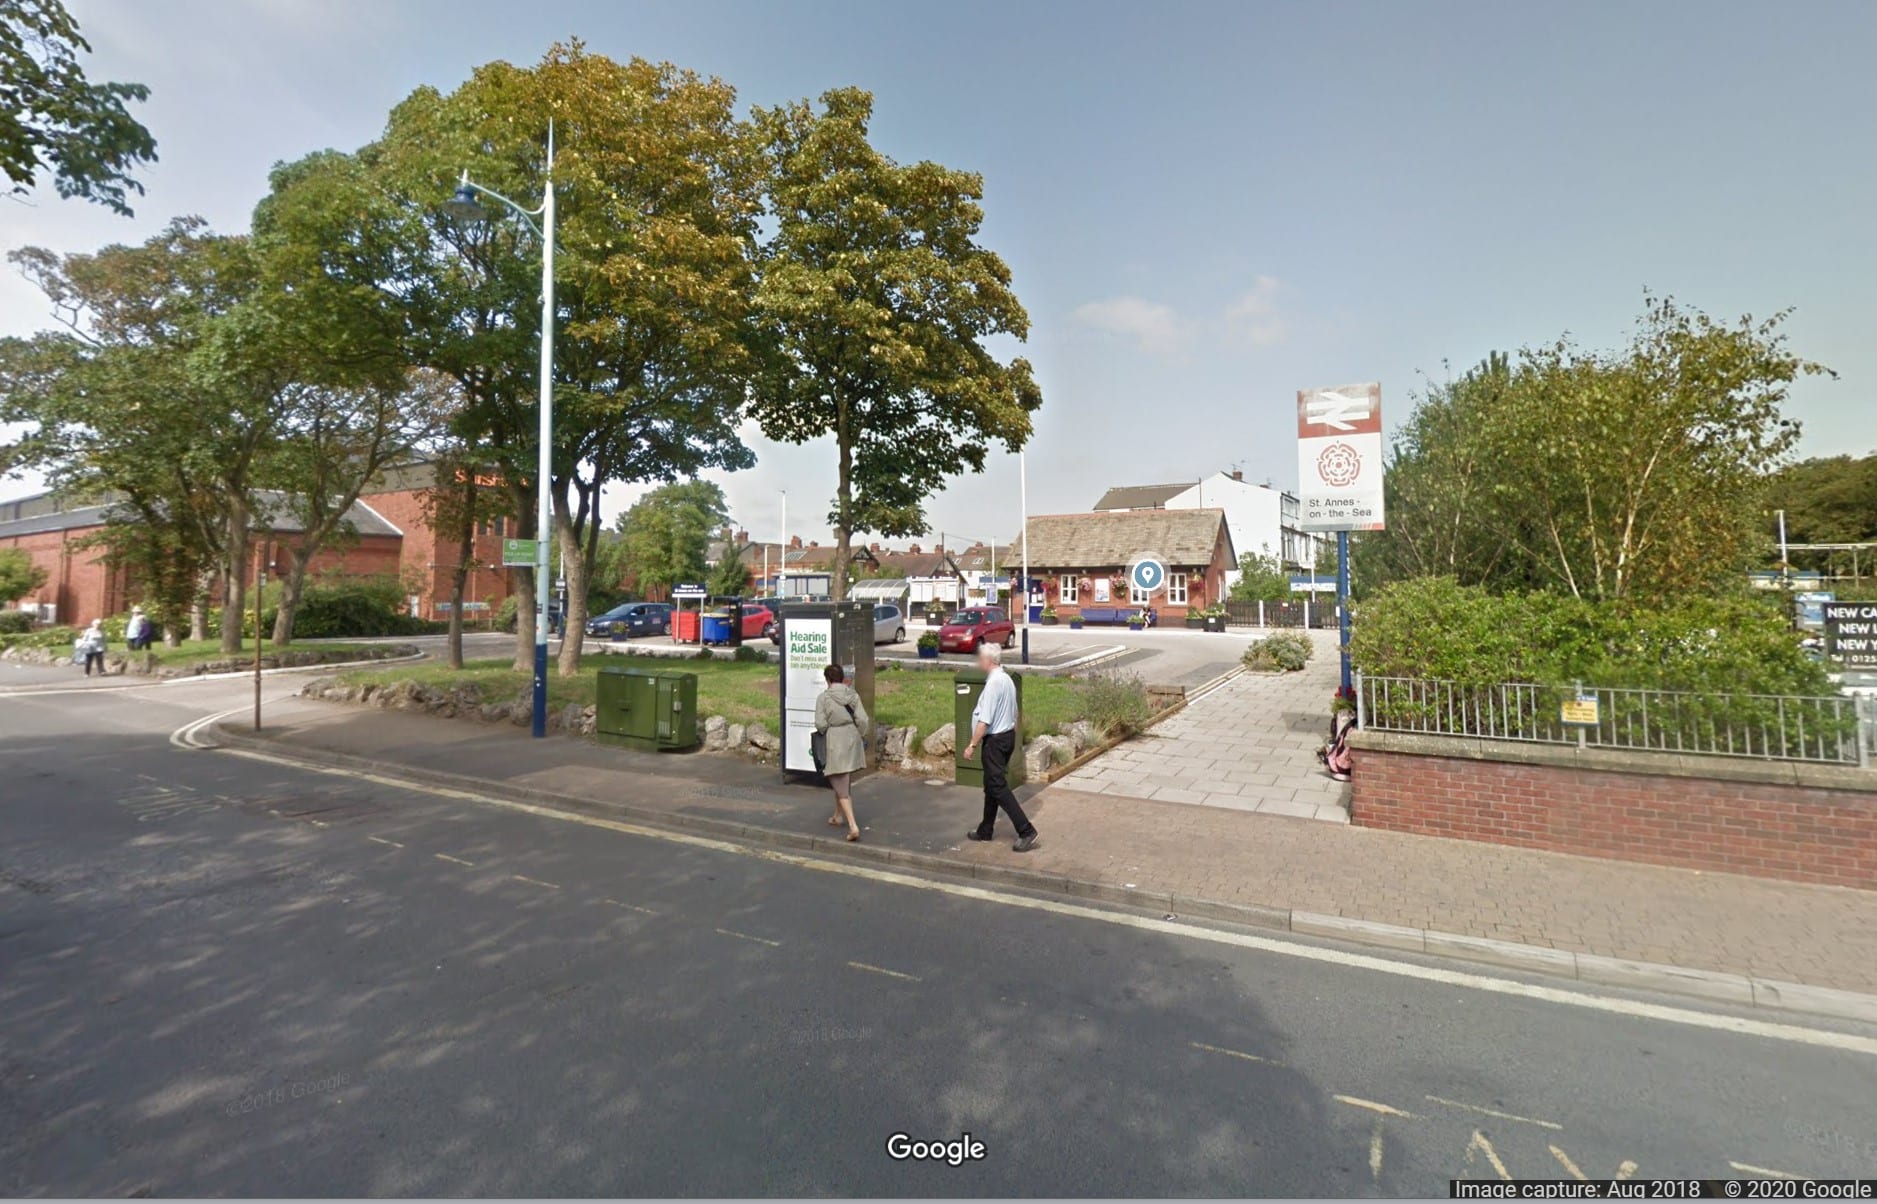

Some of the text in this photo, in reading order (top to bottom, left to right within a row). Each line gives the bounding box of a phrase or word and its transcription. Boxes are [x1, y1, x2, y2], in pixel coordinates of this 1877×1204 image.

[1325, 498, 1354, 507] Annes
[1352, 508, 1372, 517] Sea
[1827, 607, 1858, 618] NEW
[1839, 623, 1870, 634] NEW
[790, 631, 827, 644] Hearing
[791, 643, 827, 653] Aid Sale
[1837, 639, 1868, 650] NEW
